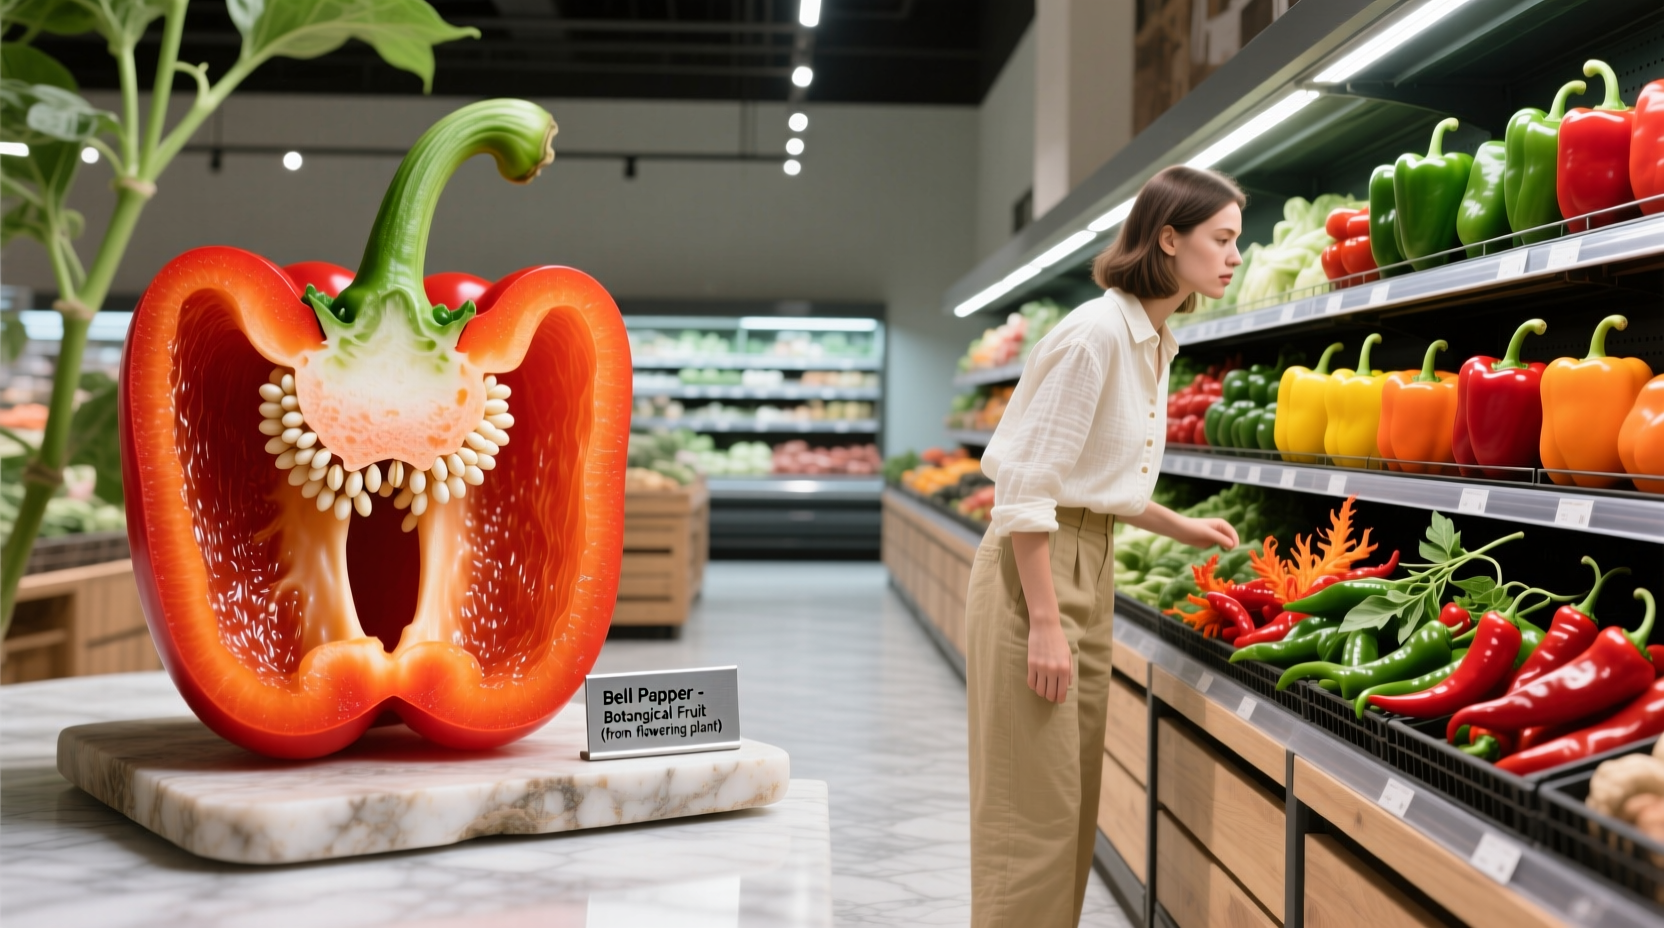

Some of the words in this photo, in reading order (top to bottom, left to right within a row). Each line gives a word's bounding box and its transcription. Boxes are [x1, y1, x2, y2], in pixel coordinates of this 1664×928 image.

[603, 687, 633, 705] Bell
[638, 687, 693, 705] Papper
[677, 704, 707, 719] Fruit
[600, 727, 632, 743] (from
[636, 724, 687, 738] flowering
[690, 719, 722, 737] plant)
